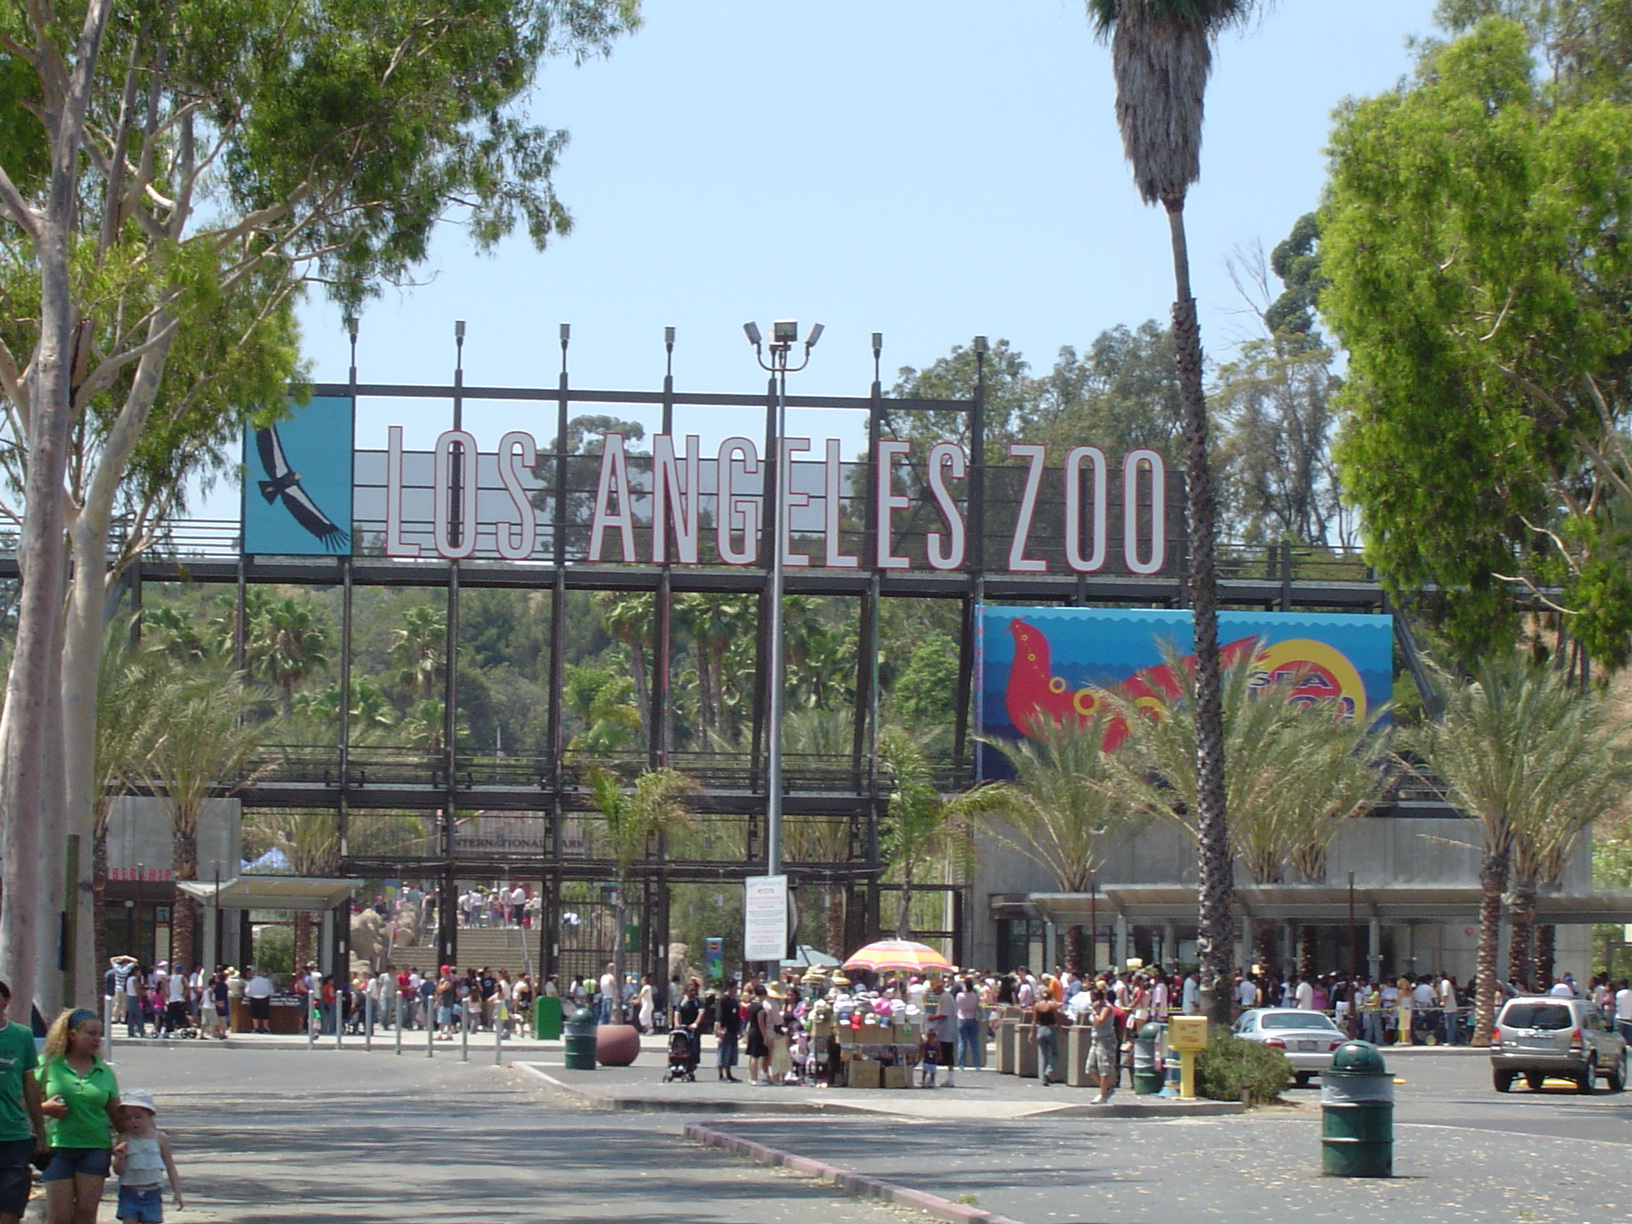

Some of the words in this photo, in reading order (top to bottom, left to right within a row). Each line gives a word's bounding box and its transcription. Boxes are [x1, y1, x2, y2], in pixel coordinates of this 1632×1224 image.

[386, 426, 537, 560] LOS
[587, 431, 967, 572] ANGELES
[1008, 442, 1166, 575] ZOO
